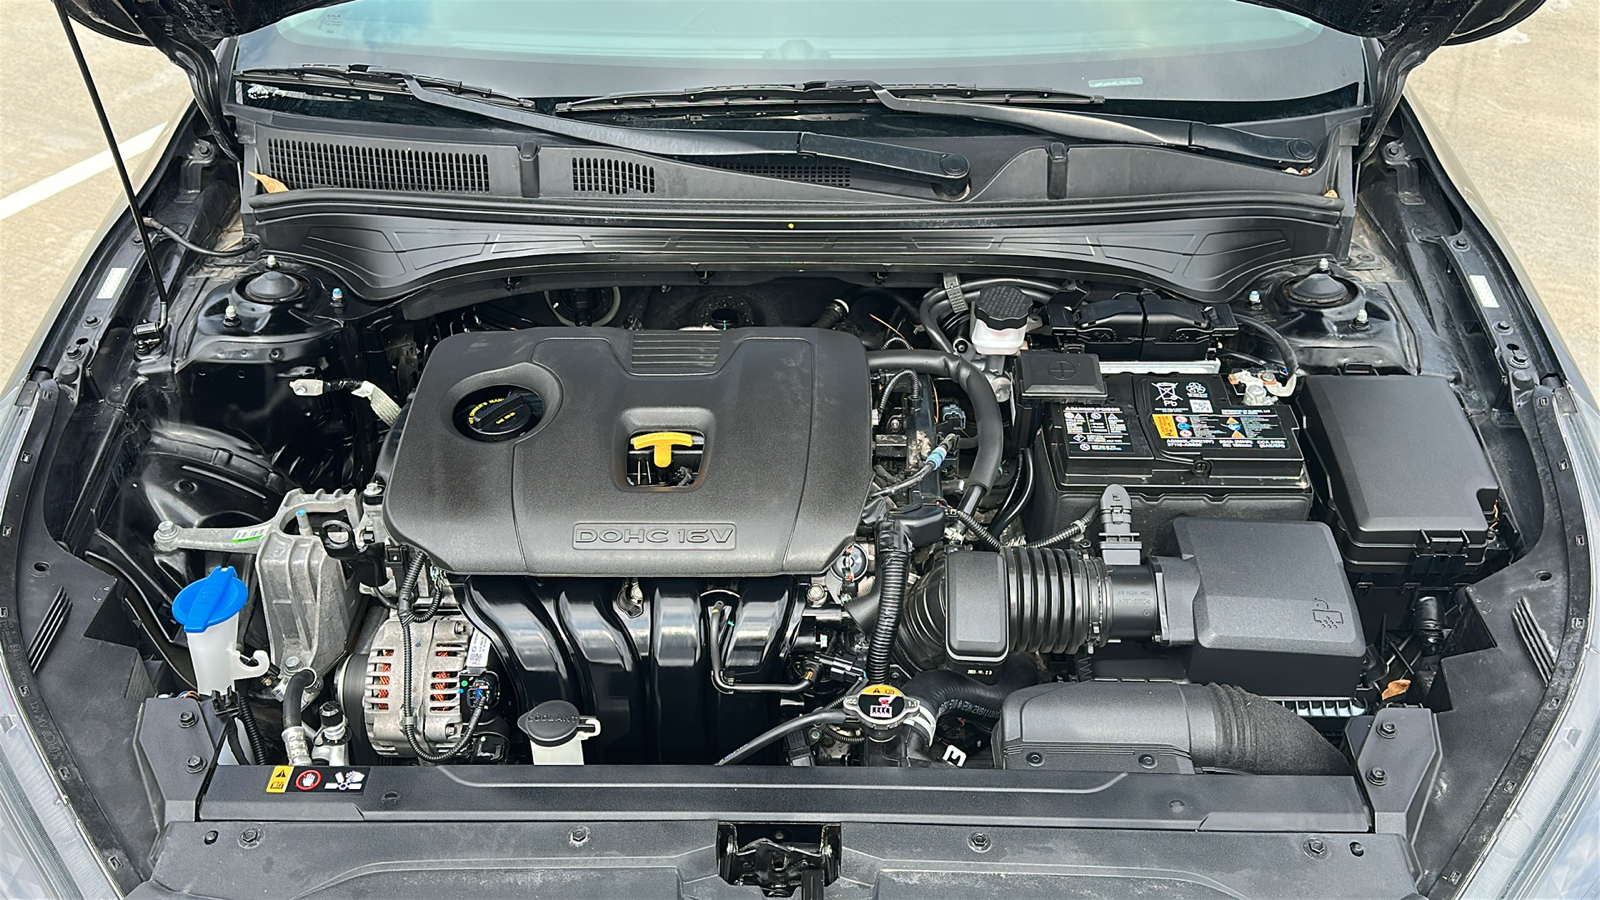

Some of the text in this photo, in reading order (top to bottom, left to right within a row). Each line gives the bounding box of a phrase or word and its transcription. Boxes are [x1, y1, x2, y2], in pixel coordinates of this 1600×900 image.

[575, 528, 734, 544] DOHC 16V
[29, 701, 41, 714] 12V
[527, 713, 579, 724] COOLANT
